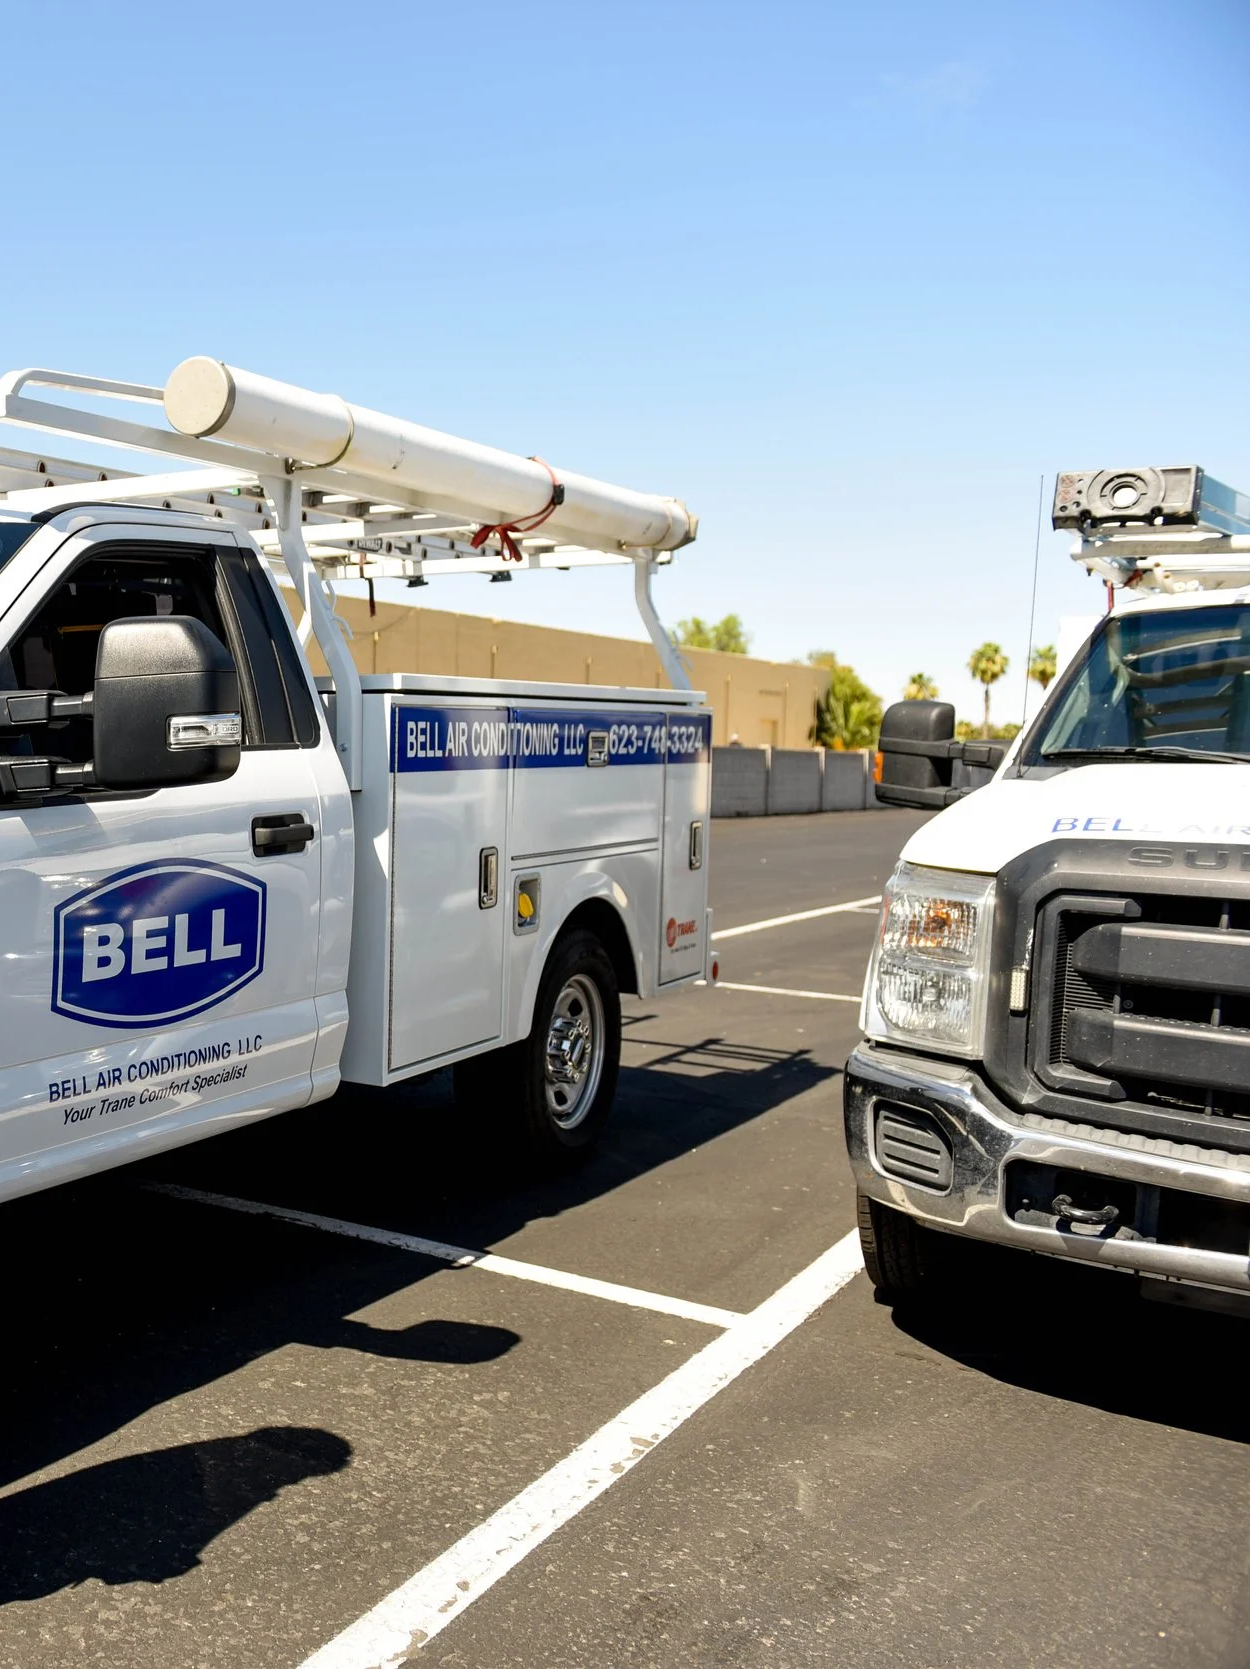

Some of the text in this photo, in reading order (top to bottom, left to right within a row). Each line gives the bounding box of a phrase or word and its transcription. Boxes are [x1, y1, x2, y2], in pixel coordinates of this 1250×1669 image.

[406, 720, 704, 758] BELL AIR CONDITIONING LLC 623-748-3324
[1051, 817, 1163, 834] BELL
[81, 908, 242, 983] BELL
[48, 1034, 262, 1103] BELL AIR CONDITIONING LLC
[63, 1063, 248, 1126] Your Trane Comfort Specialist
